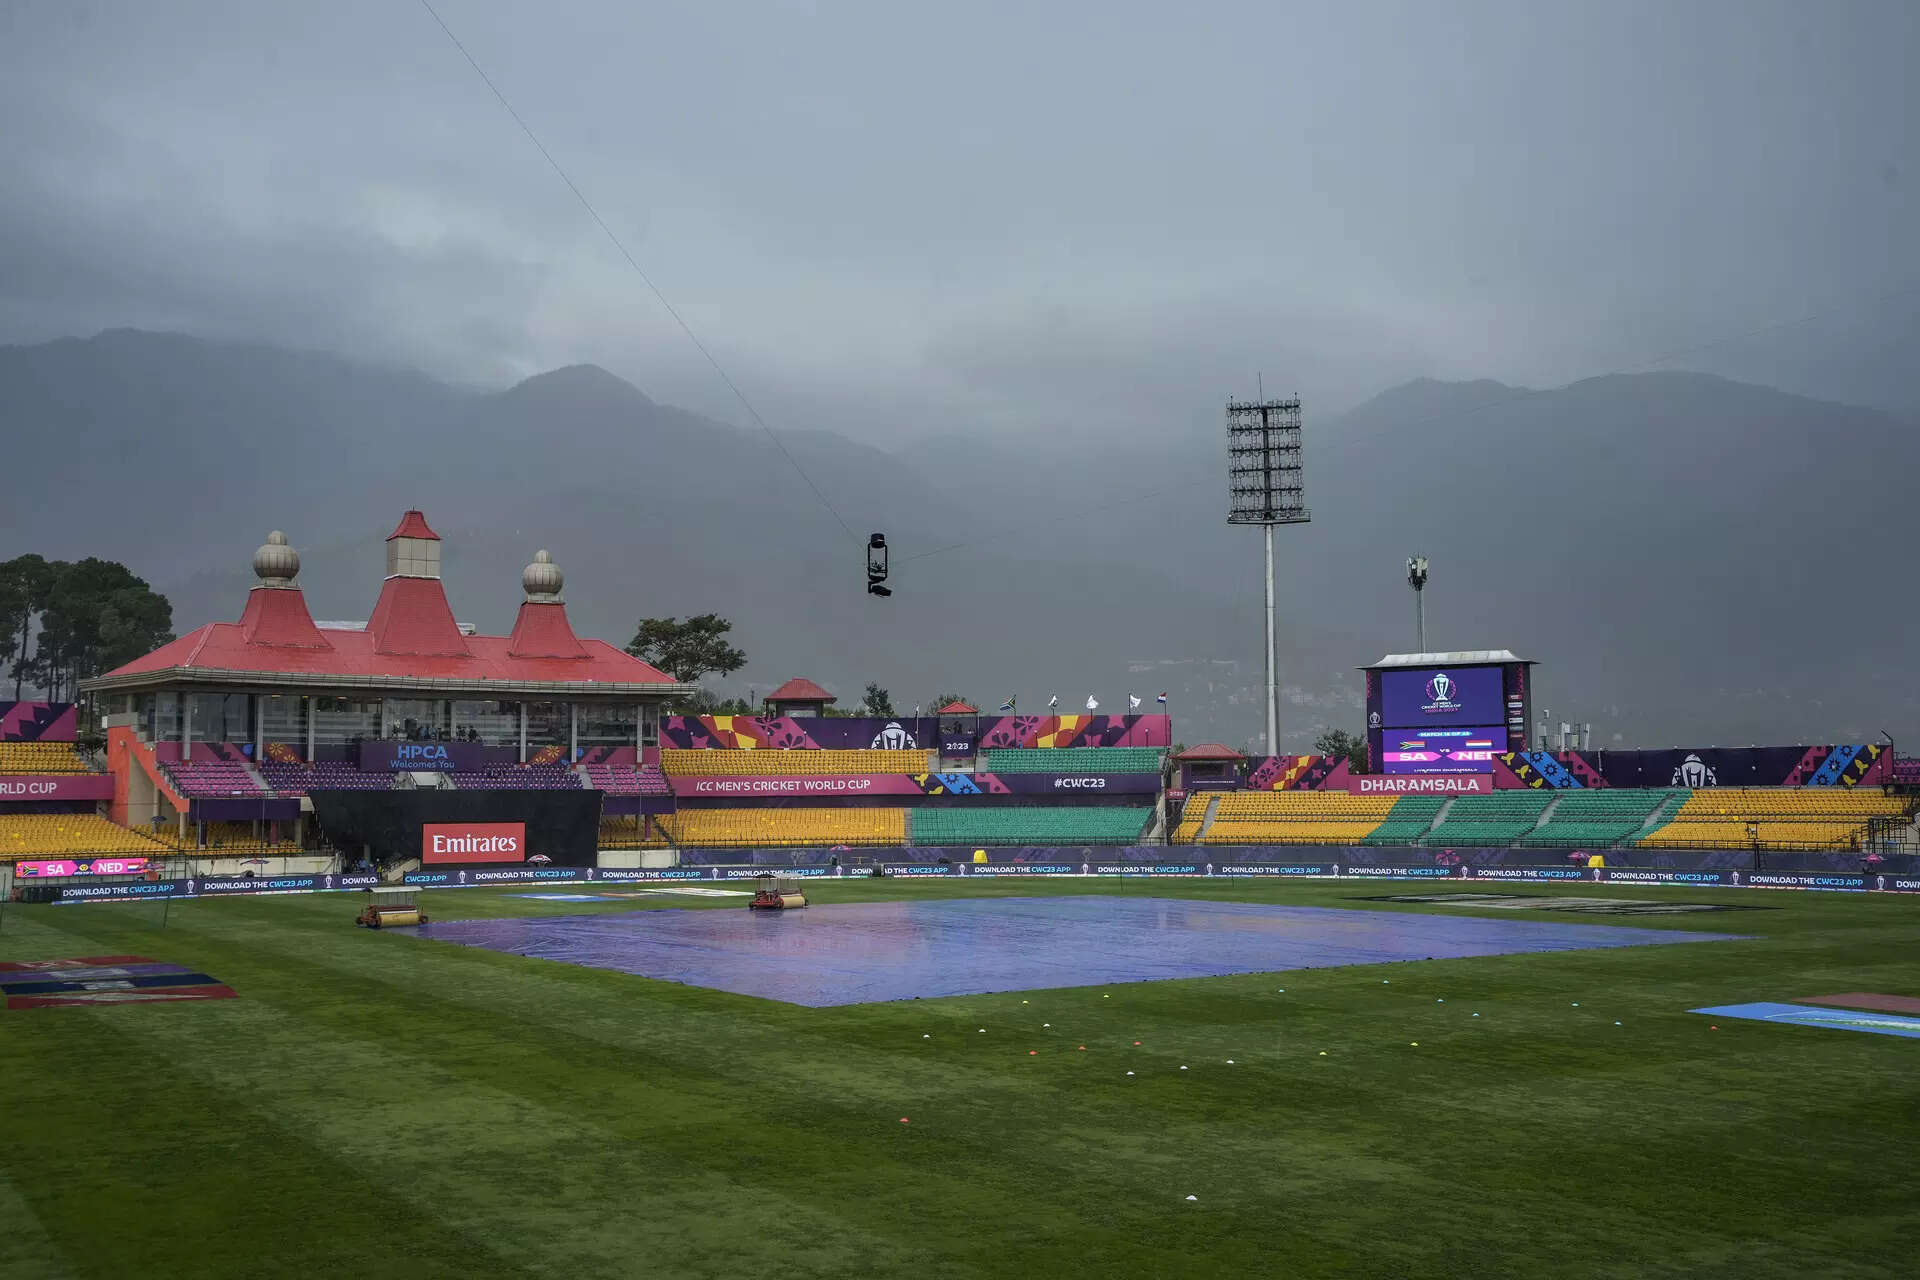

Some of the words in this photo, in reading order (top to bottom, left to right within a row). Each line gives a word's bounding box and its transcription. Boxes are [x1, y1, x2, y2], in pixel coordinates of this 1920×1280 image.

[398, 746, 448, 758] HPCA
[390, 760, 436, 768] Welcomes
[438, 760, 454, 768] You
[30, 782, 57, 794] CUP
[696, 782, 713, 791] ICC
[716, 782, 750, 791] MEN'S
[753, 781, 800, 791] CRICKET
[804, 780, 845, 790] WORLD
[848, 780, 870, 789] CUP
[1054, 778, 1106, 788] #CWC23
[1360, 779, 1480, 791] DHARAMSALA
[433, 834, 516, 853] Emirates
[47, 865, 64, 875] SA
[98, 863, 123, 873] NED
[404, 875, 430, 883] CWC23
[475, 872, 519, 880] DOWNLOAD
[560, 870, 576, 878] APP
[602, 871, 644, 879] DOWNLOAD
[1610, 872, 1656, 880] DOWNLOAD
[204, 882, 251, 890] DOWNLOAD
[269, 880, 295, 888] CWC23
[1750, 875, 1797, 884] DOWNLOAD
[1816, 878, 1845, 886] CWC23
[1846, 879, 1864, 887] APP
[62, 887, 110, 896] DOWNLOAD
[129, 885, 156, 894] CWC23
[158, 884, 175, 893] APP
